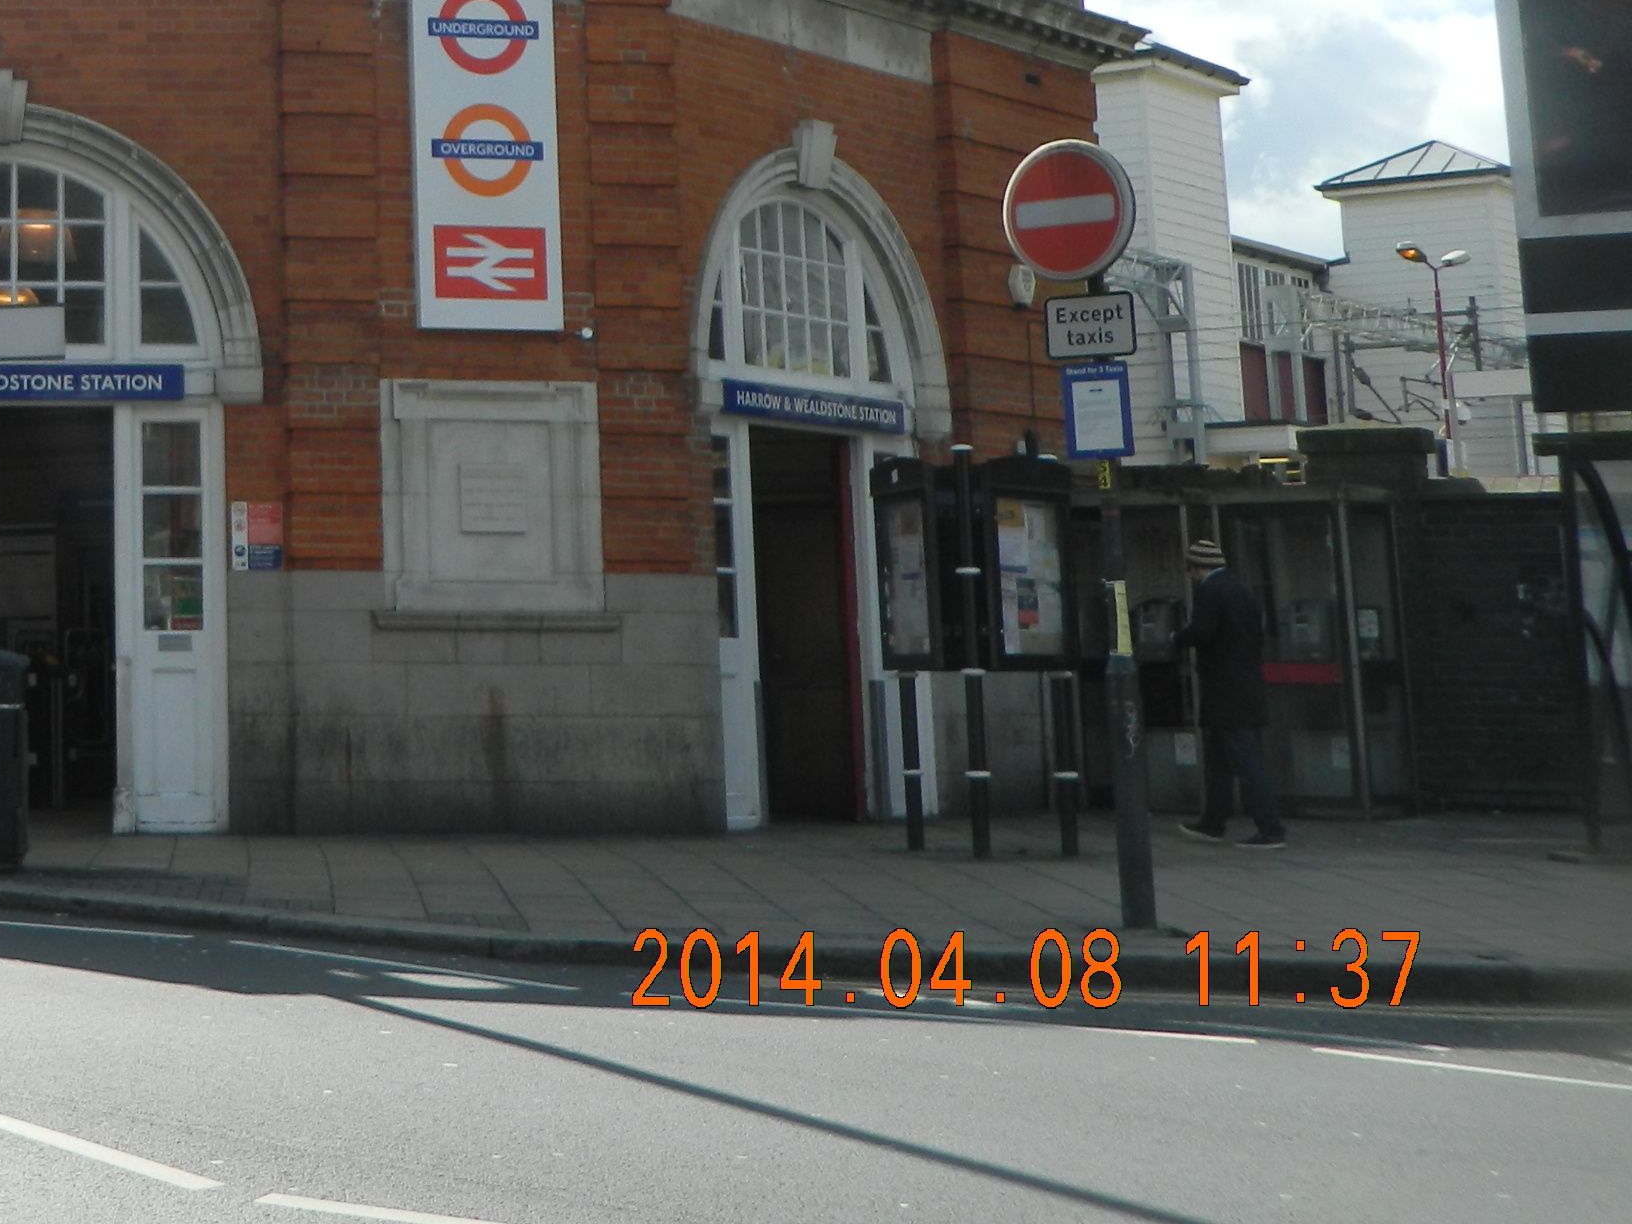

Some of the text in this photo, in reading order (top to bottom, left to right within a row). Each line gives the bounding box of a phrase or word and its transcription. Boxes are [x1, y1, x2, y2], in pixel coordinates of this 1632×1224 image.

[432, 22, 535, 37] UNDERGROUND
[440, 142, 535, 157] OVERGROUND
[1055, 304, 1124, 325] Except
[1066, 327, 1114, 346] taxis
[1065, 367, 1086, 376] Stand
[80, 373, 163, 391] STATION
[736, 390, 897, 425] HARROW & WEALDSTONE STATION
